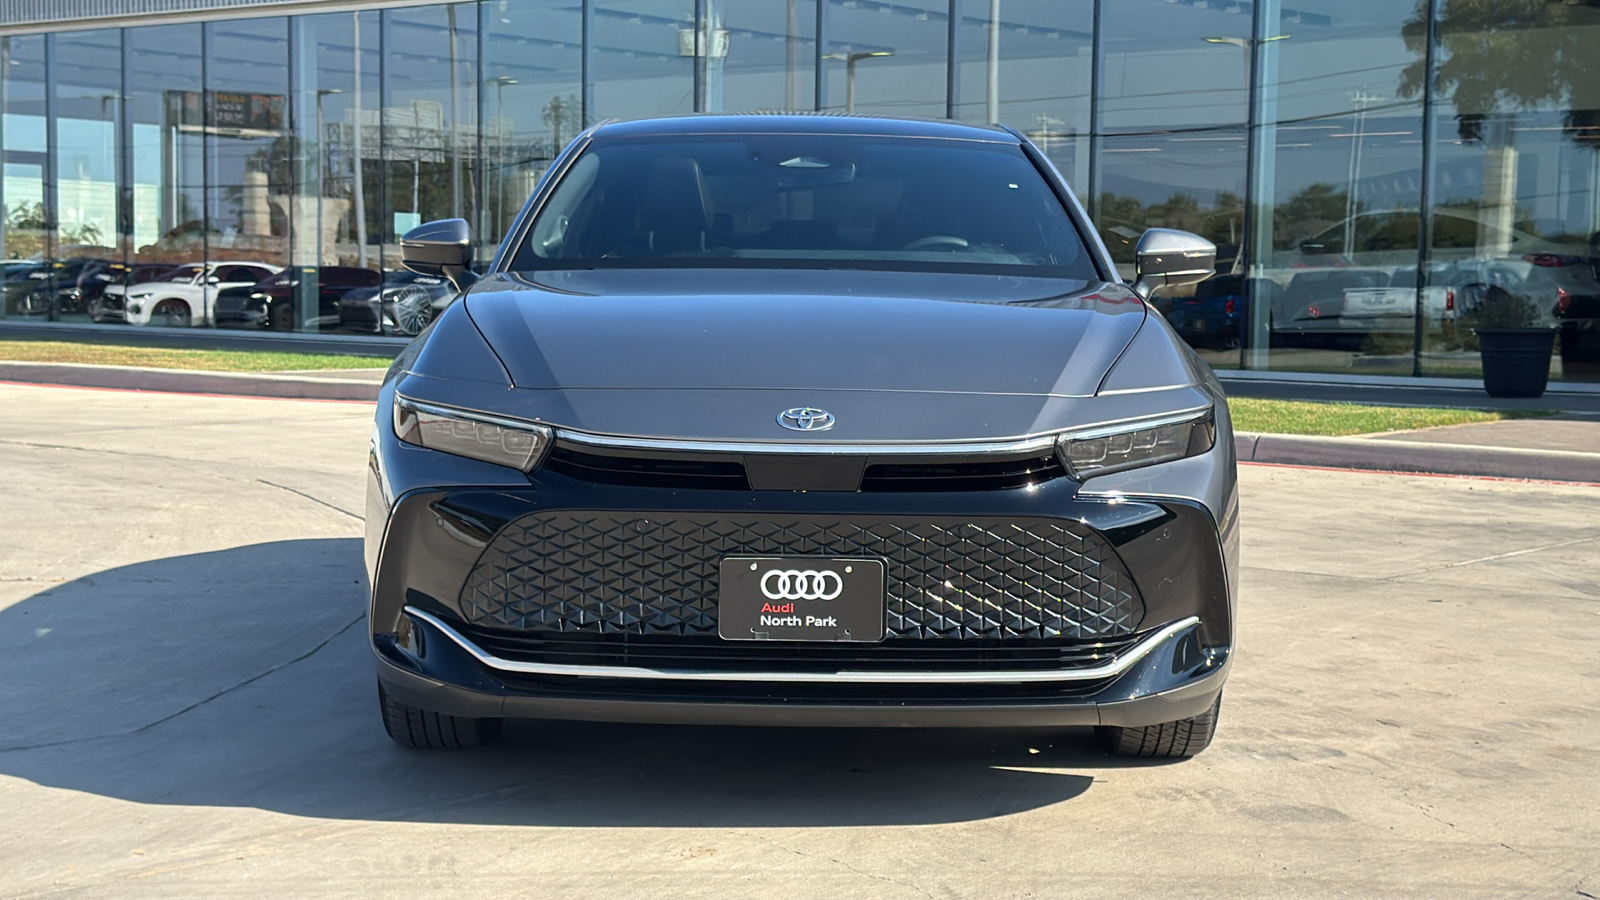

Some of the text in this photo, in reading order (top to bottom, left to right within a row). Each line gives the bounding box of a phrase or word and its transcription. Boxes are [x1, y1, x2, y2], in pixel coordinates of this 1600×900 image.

[761, 602, 794, 613] Audi
[760, 615, 837, 627] North Park
